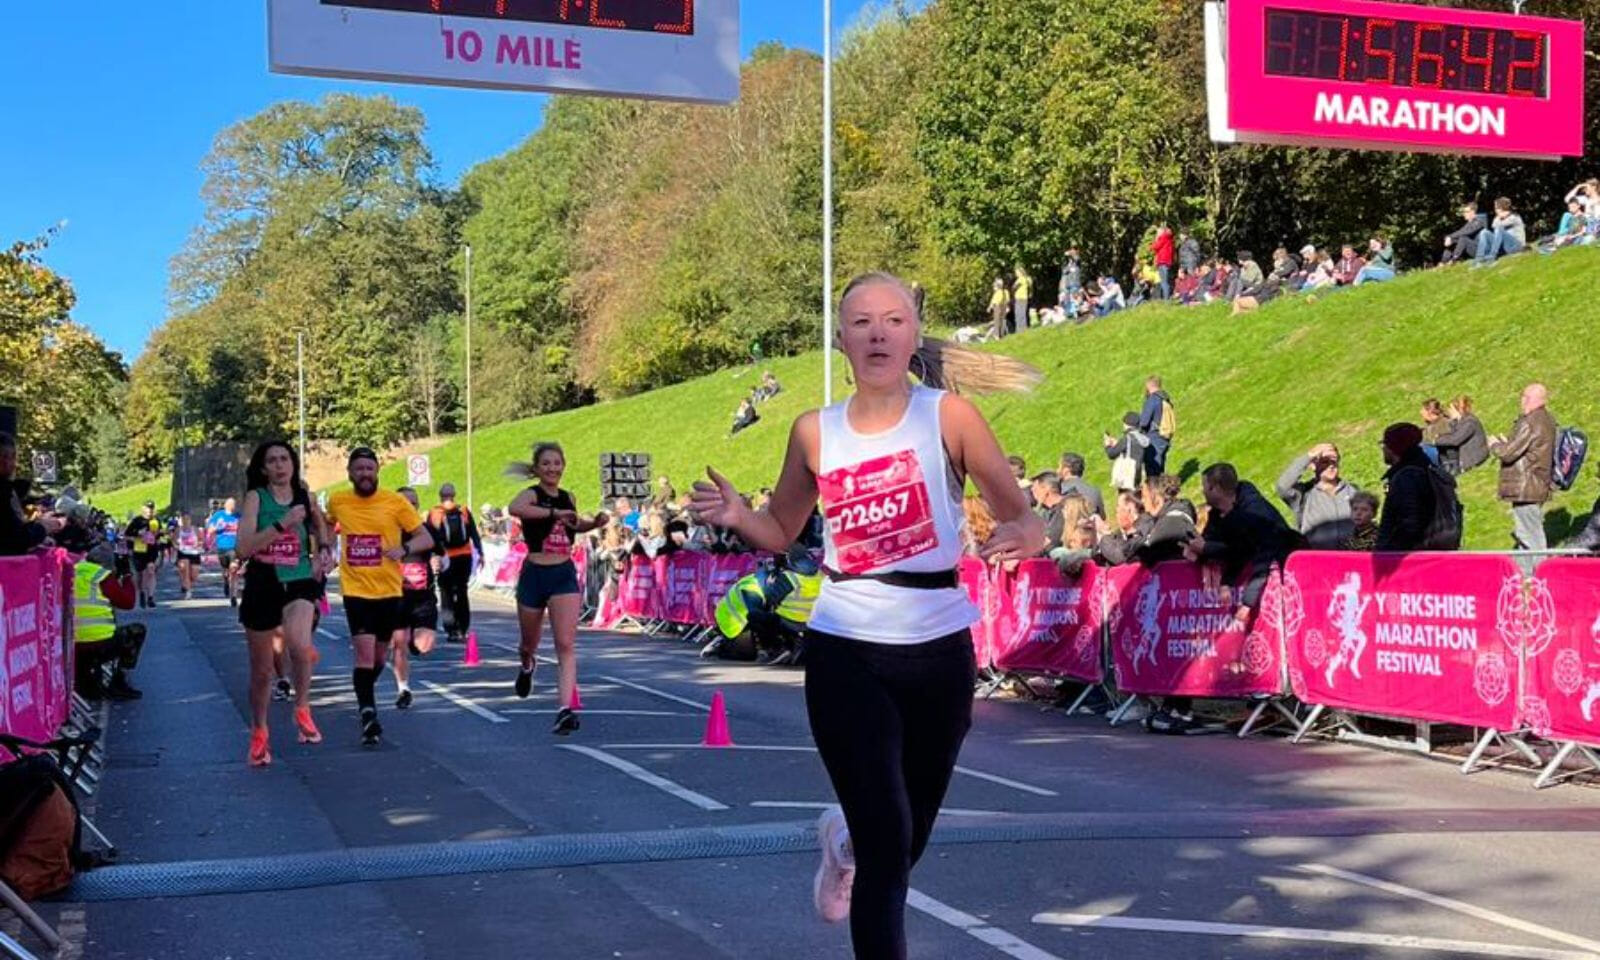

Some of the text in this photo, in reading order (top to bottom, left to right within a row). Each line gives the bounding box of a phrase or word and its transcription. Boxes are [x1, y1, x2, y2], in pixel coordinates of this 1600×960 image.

[441, 30, 581, 70] 10 MILE
[1314, 92, 1505, 136] MARATHON
[841, 490, 909, 531] 22667
[1376, 623, 1478, 650] MARATHON
[1376, 652, 1443, 676] FESTIVAL
